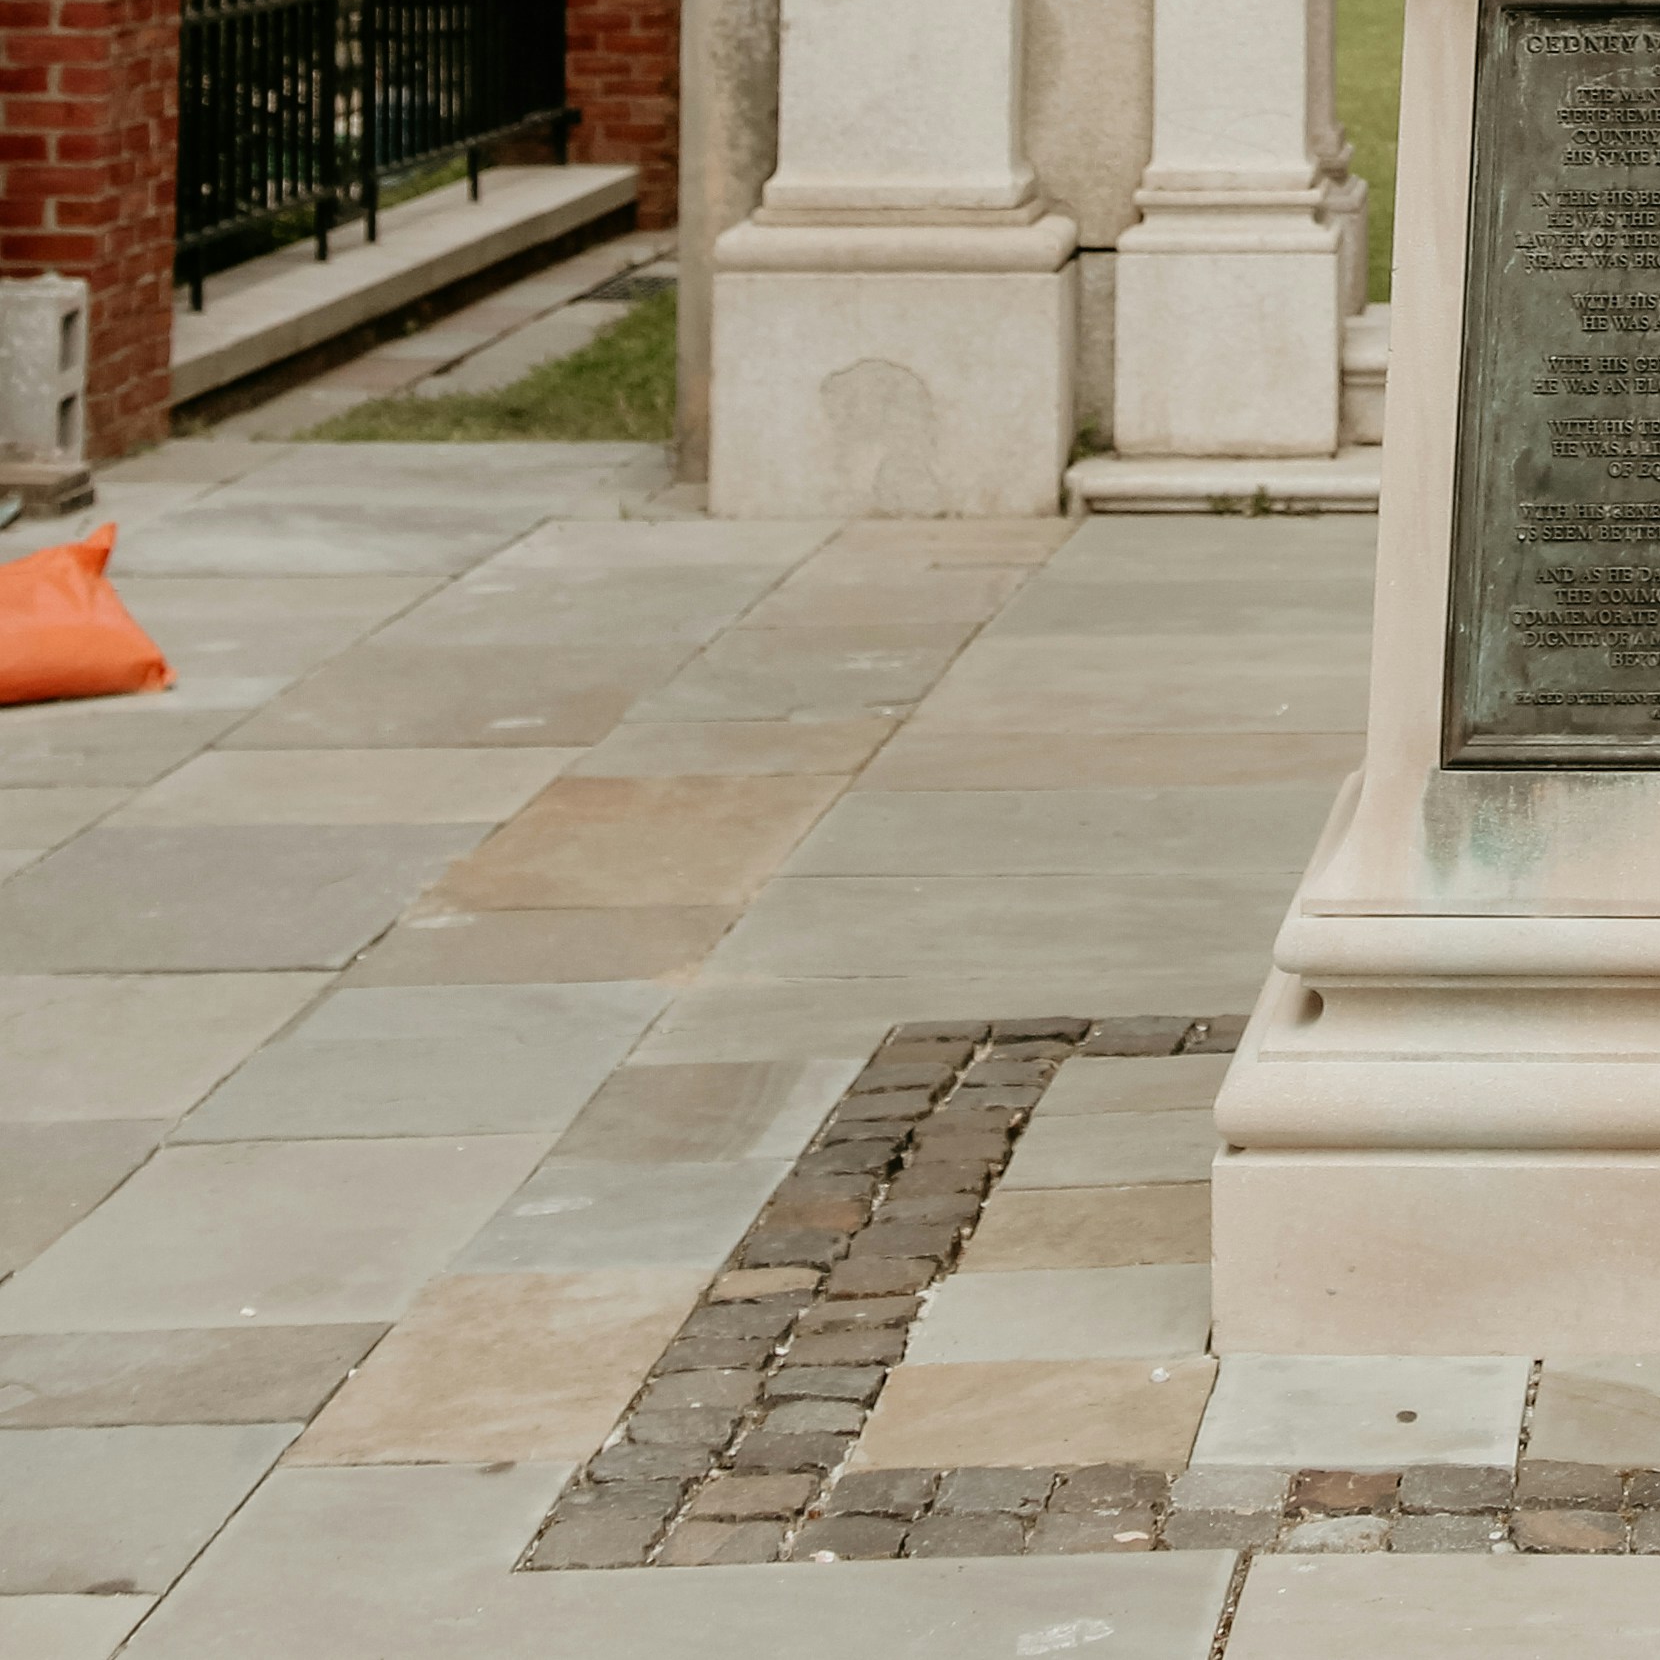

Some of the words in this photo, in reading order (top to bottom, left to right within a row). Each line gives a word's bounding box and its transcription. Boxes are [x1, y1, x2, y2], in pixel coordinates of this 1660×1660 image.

[1526, 34, 1639, 54] GEDNEY
[1576, 86, 1615, 103] THE
[1619, 86, 1657, 103] MAN
[1556, 107, 1610, 124] HERE
[1571, 128, 1660, 145] COUNTRY
[1562, 149, 1595, 166] HIS
[1598, 149, 1650, 166] STATE
[1531, 191, 1551, 207] IN
[1555, 191, 1599, 207] THIS
[1603, 190, 1634, 207] HIS
[1547, 212, 1574, 228] HE
[1576, 211, 1616, 228] WAS
[1619, 211, 1656, 228] THE
[1514, 232, 1587, 249] LAWYER
[1591, 232, 1617, 248] OF
[1620, 232, 1659, 248] THE
[1523, 252, 1588, 270] REACH
[1592, 252, 1629, 269] WAS
[1572, 293, 1623, 310] WITH
[1626, 293, 1657, 310] HIS
[1581, 315, 1609, 332] HE
[1612, 315, 1649, 332] WAS
[1544, 355, 1593, 373] WITH
[1597, 355, 1629, 373] HIS
[1532, 378, 1559, 395] HE
[1562, 378, 1600, 395] WAS
[1604, 378, 1630, 395] AN
[1547, 419, 1597, 436] WITH
[1601, 419, 1635, 436] HIS
[1551, 440, 1578, 458] HE
[1581, 440, 1621, 458] WAS
[1623, 440, 1638, 457] A
[1608, 461, 1635, 478] OF
[1519, 503, 1569, 520] WITH
[1574, 503, 1604, 520] HIS
[1514, 525, 1537, 542] US
[1541, 525, 1593, 542] SEEM
[1536, 567, 1575, 583] AND
[1580, 567, 1604, 583] AS
[1606, 567, 1634, 583] HE
[1554, 588, 1594, 605] THE
[1512, 609, 1658, 626] COMMEMORATE
[1522, 630, 1600, 648] DIGNITY
[1605, 630, 1631, 647] OF
[1632, 630, 1646, 646] A
[1515, 692, 1564, 705] PLACED
[1567, 692, 1582, 705] BY
[1584, 692, 1611, 705] THE
[1613, 692, 1647, 705] MANY
